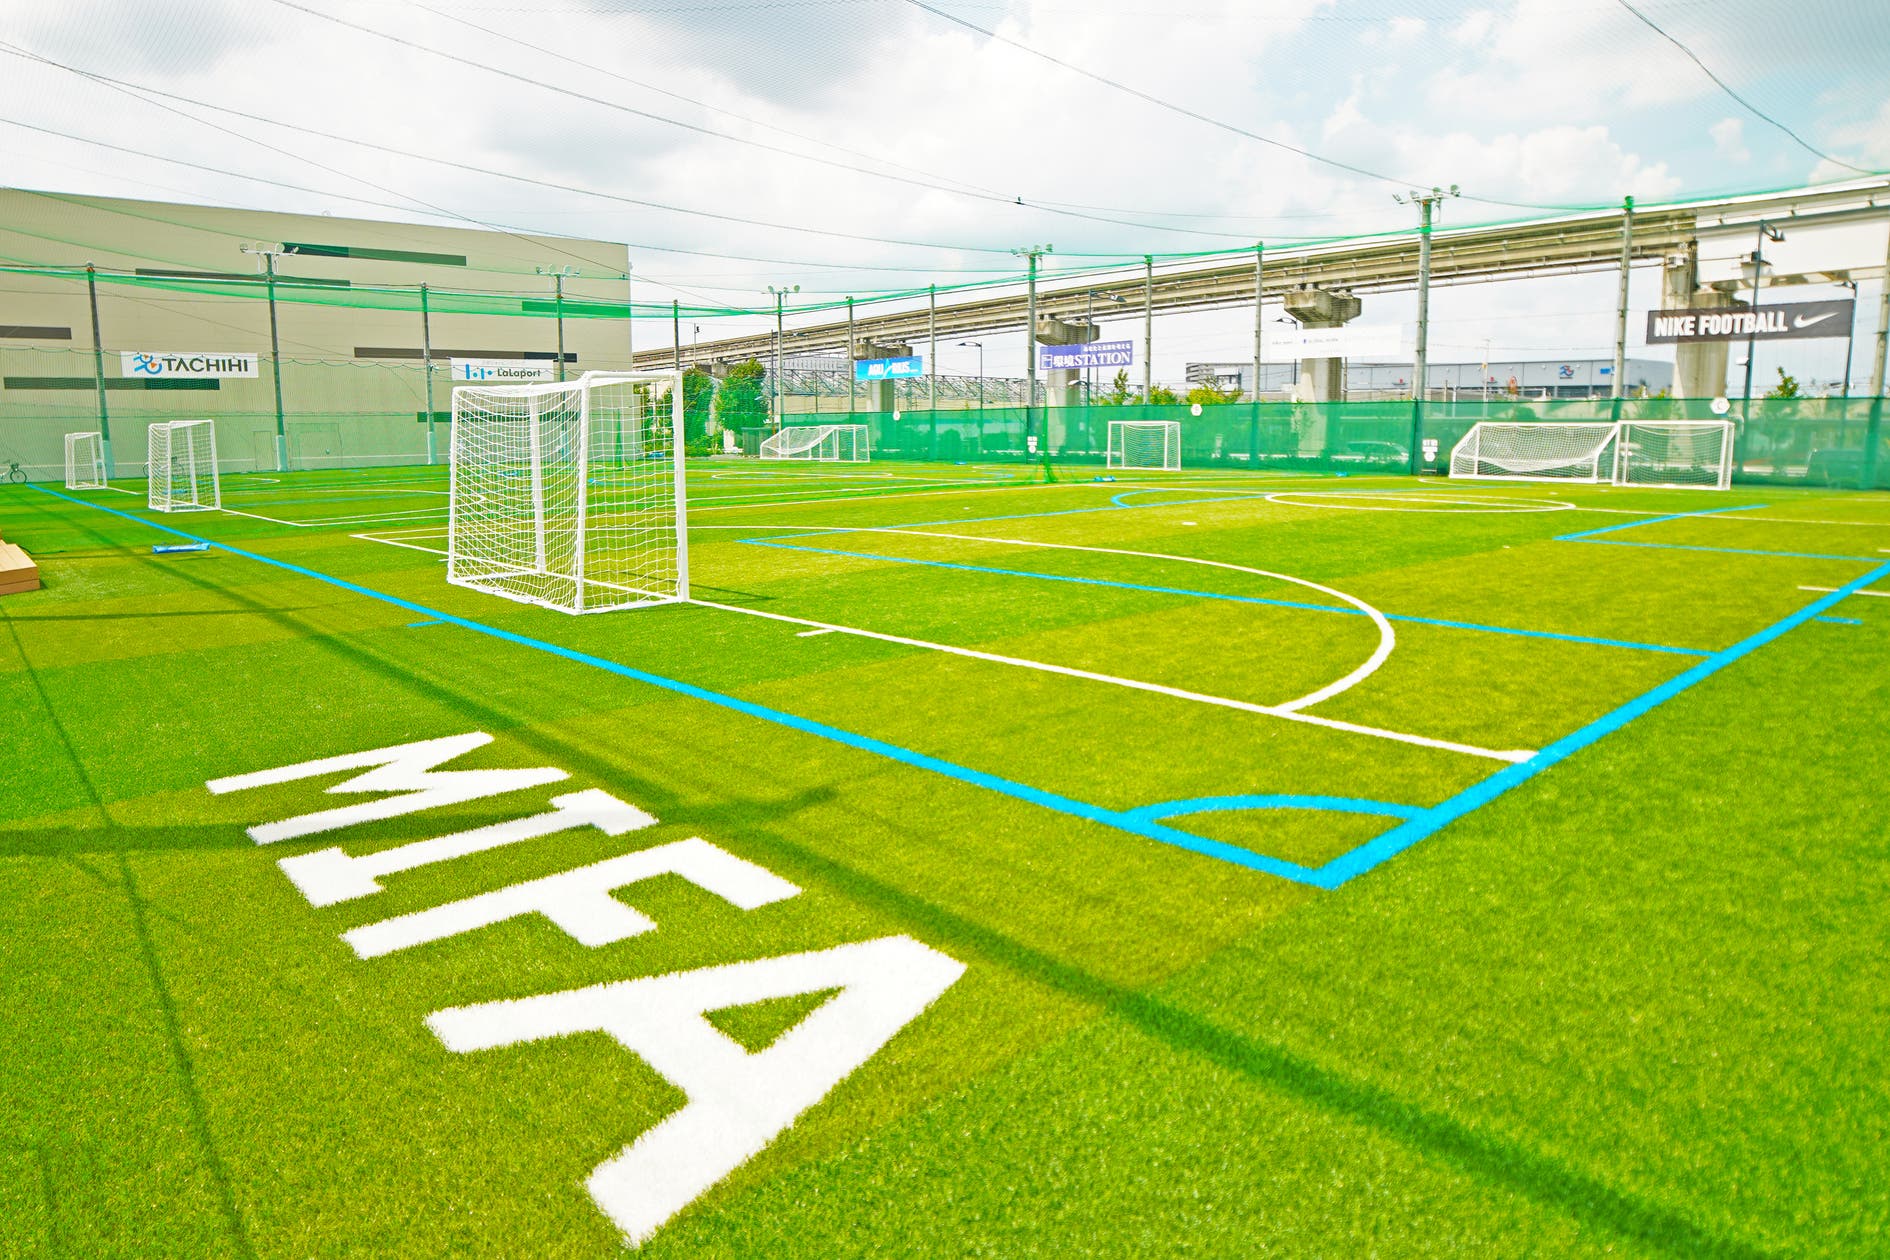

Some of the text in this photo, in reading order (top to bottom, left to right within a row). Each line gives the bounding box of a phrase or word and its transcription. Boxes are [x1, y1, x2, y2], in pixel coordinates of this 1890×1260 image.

[1654, 311, 1788, 337] NIKE FOOTBALL
[162, 358, 249, 372] TACHIHI
[497, 368, 541, 378] LaLaport
[207, 731, 968, 1247] MIFA
